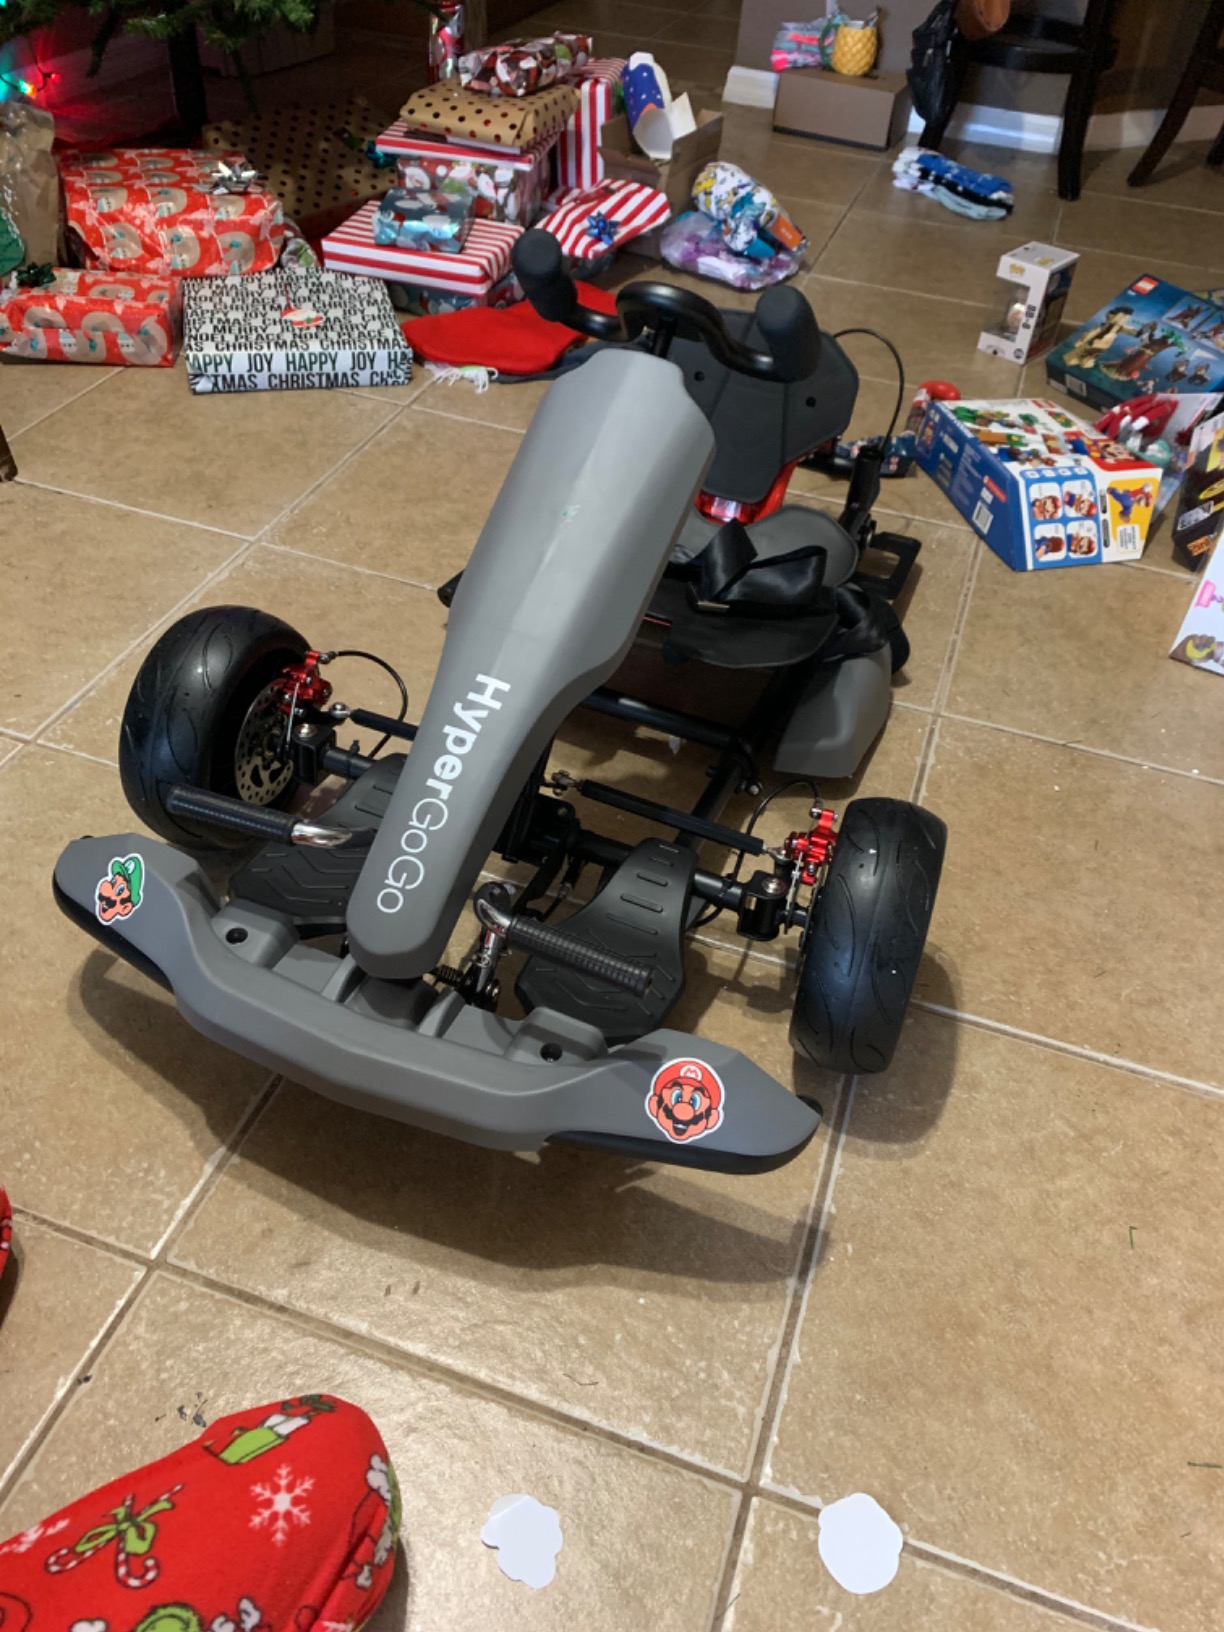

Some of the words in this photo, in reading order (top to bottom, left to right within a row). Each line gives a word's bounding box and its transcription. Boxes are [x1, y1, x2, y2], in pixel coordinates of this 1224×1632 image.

[246, 352, 274, 373] JOY
[285, 351, 338, 372] HAPPY
[350, 351, 377, 371] JOY
[267, 371, 360, 390] CHRISTMAS
[376, 673, 512, 914] HyperGoGo
